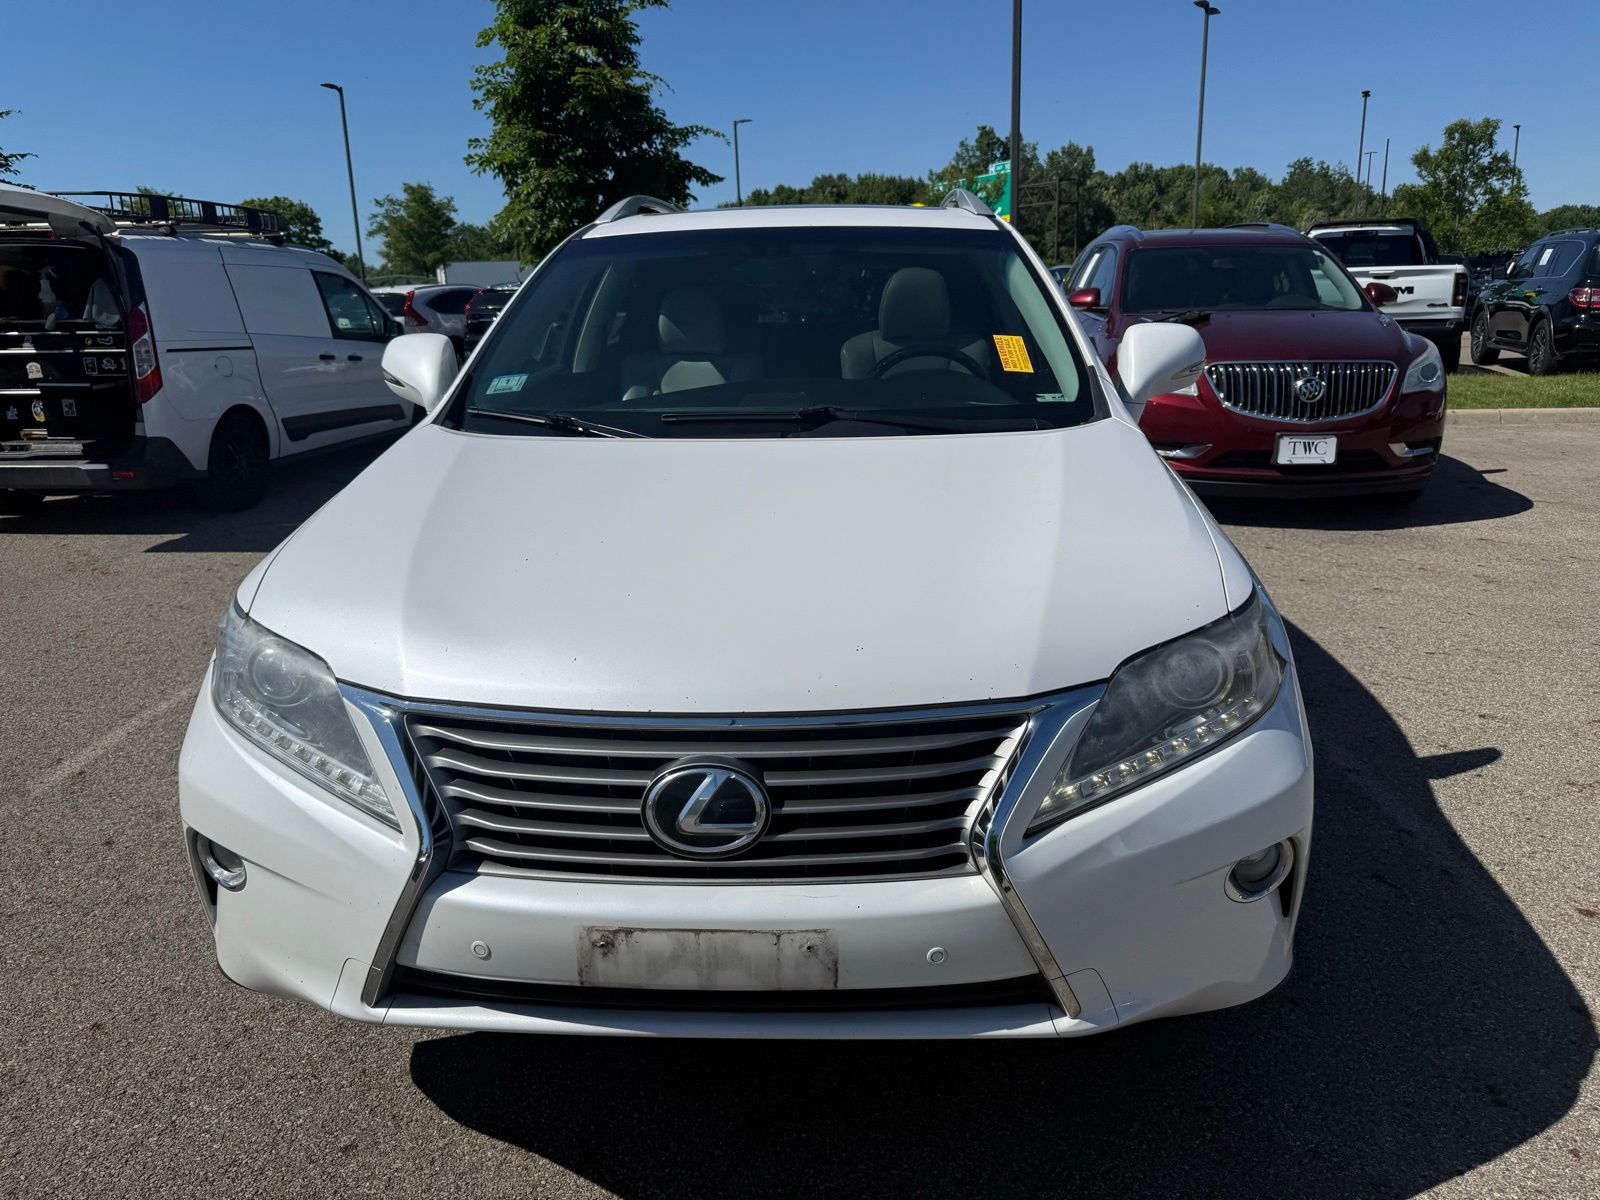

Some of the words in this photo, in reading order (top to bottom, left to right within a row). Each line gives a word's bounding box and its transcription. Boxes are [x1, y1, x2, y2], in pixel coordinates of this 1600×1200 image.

[995, 336, 1007, 356] VEHICLE
[1002, 338, 1011, 348] SALE
[1002, 357, 1011, 368] THIS
[1010, 359, 1018, 368] NOT
[1288, 440, 1328, 455] TWC
